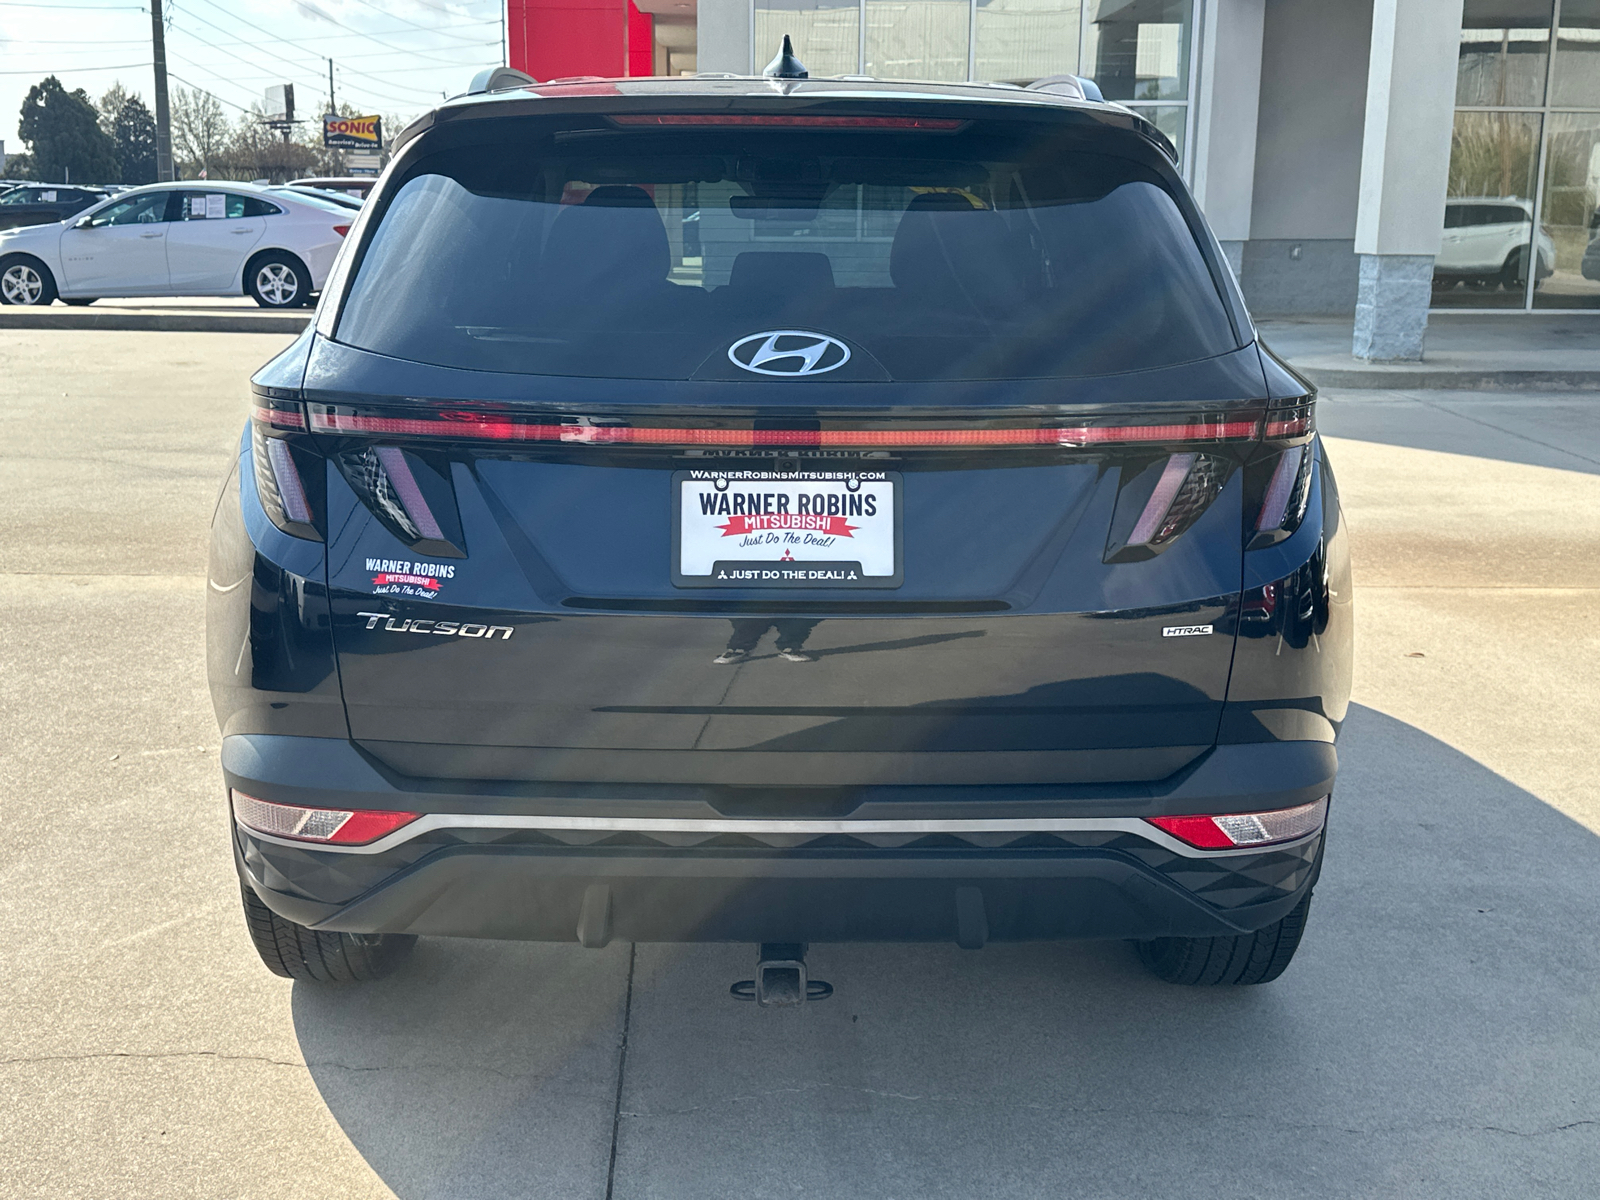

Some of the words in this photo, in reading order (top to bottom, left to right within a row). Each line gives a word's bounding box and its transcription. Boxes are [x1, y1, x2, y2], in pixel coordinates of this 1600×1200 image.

[329, 121, 375, 133] SONIC
[699, 492, 790, 516] WARNER
[798, 492, 877, 517] ROBINS
[744, 515, 831, 530] MITSUBISHI
[739, 534, 763, 548] Just
[765, 532, 780, 544] Do
[783, 532, 801, 544] The
[803, 533, 836, 548] Deal!
[365, 558, 411, 574] WARNER
[413, 562, 455, 579] ROBINS
[729, 570, 760, 580] JUST
[762, 570, 780, 580] DO
[783, 570, 807, 580] THE
[809, 570, 845, 580] DEAL!
[385, 574, 430, 586] MITSUBISHI
[373, 585, 389, 594] Just
[390, 585, 400, 593] Do
[401, 585, 414, 595] The
[415, 587, 438, 599] Deal!
[1167, 626, 1209, 635] HTRAC
